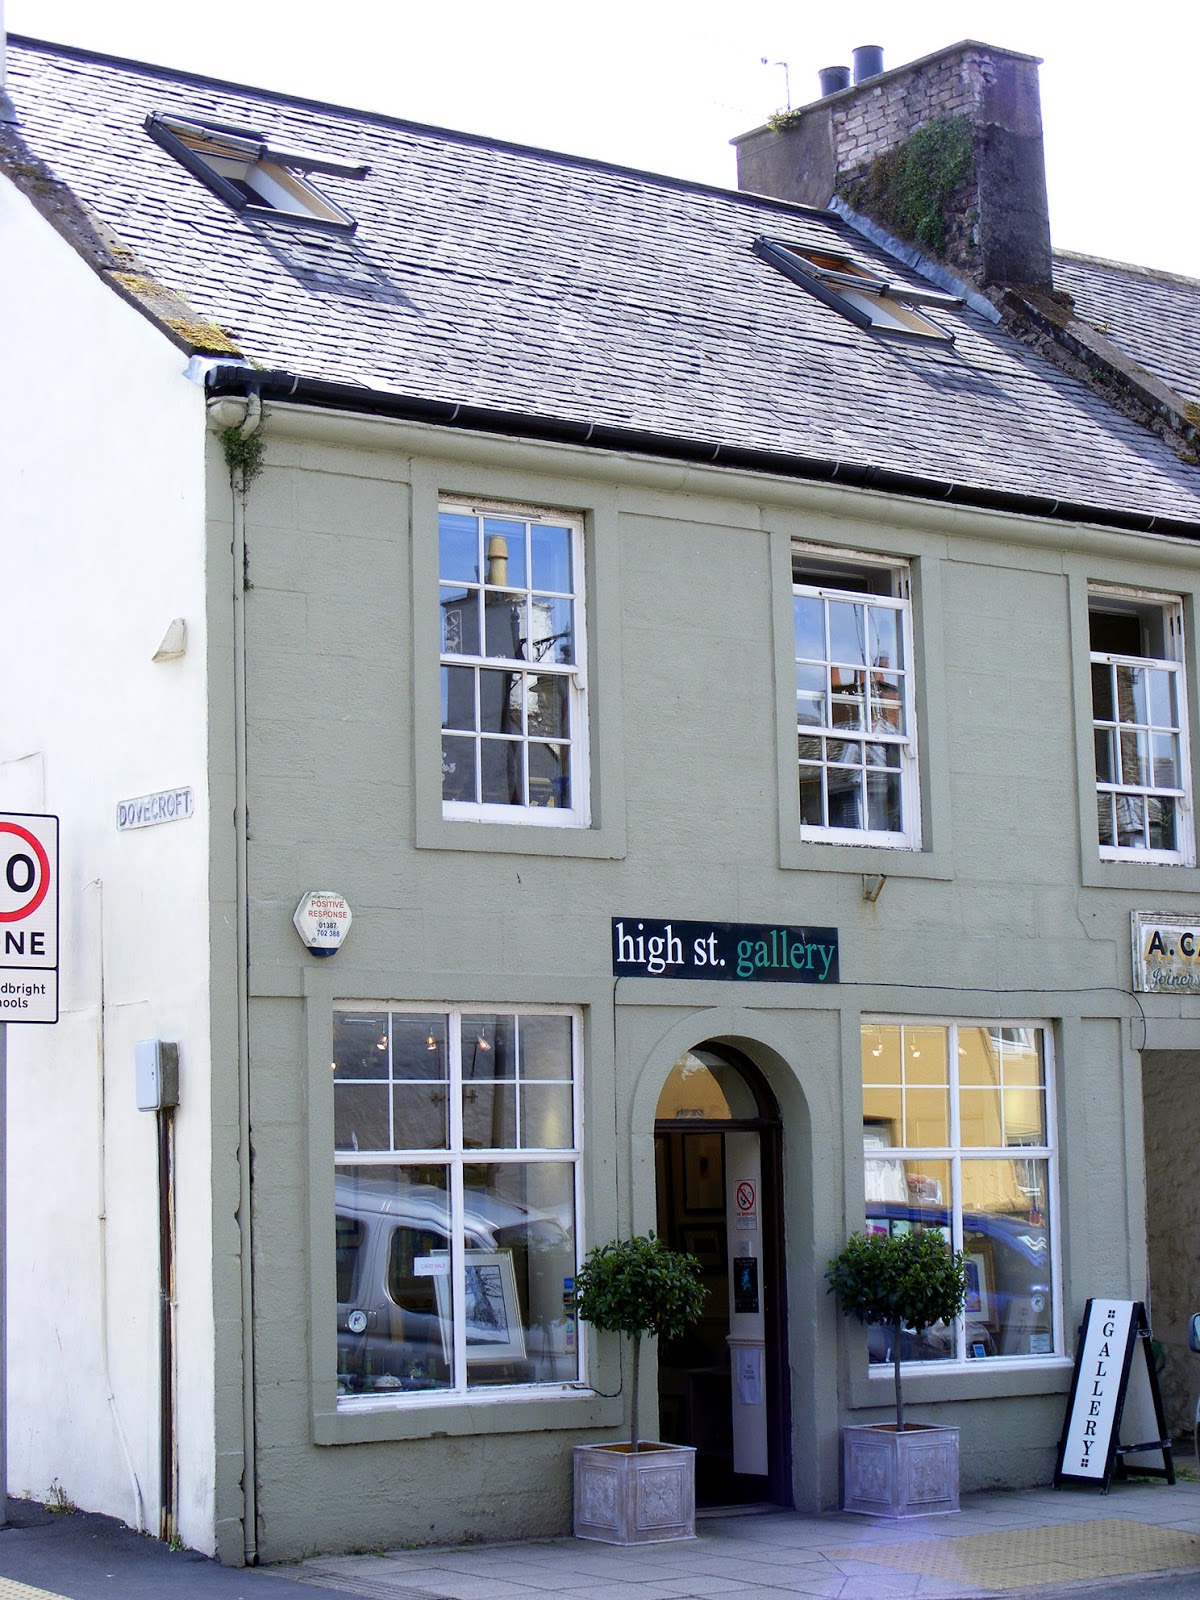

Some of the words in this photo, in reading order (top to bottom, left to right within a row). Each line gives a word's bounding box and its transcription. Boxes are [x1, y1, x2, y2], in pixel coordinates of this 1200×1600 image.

[119, 790, 190, 827] DOVECROFT
[308, 910, 348, 919] RESPONSE
[311, 900, 344, 909] POSITIVE
[615, 922, 685, 974] high
[694, 931, 726, 967] st.
[736, 929, 836, 981] gallery
[1145, 930, 1200, 960] A.C
[1083, 1321, 1115, 1456] GALLERY
